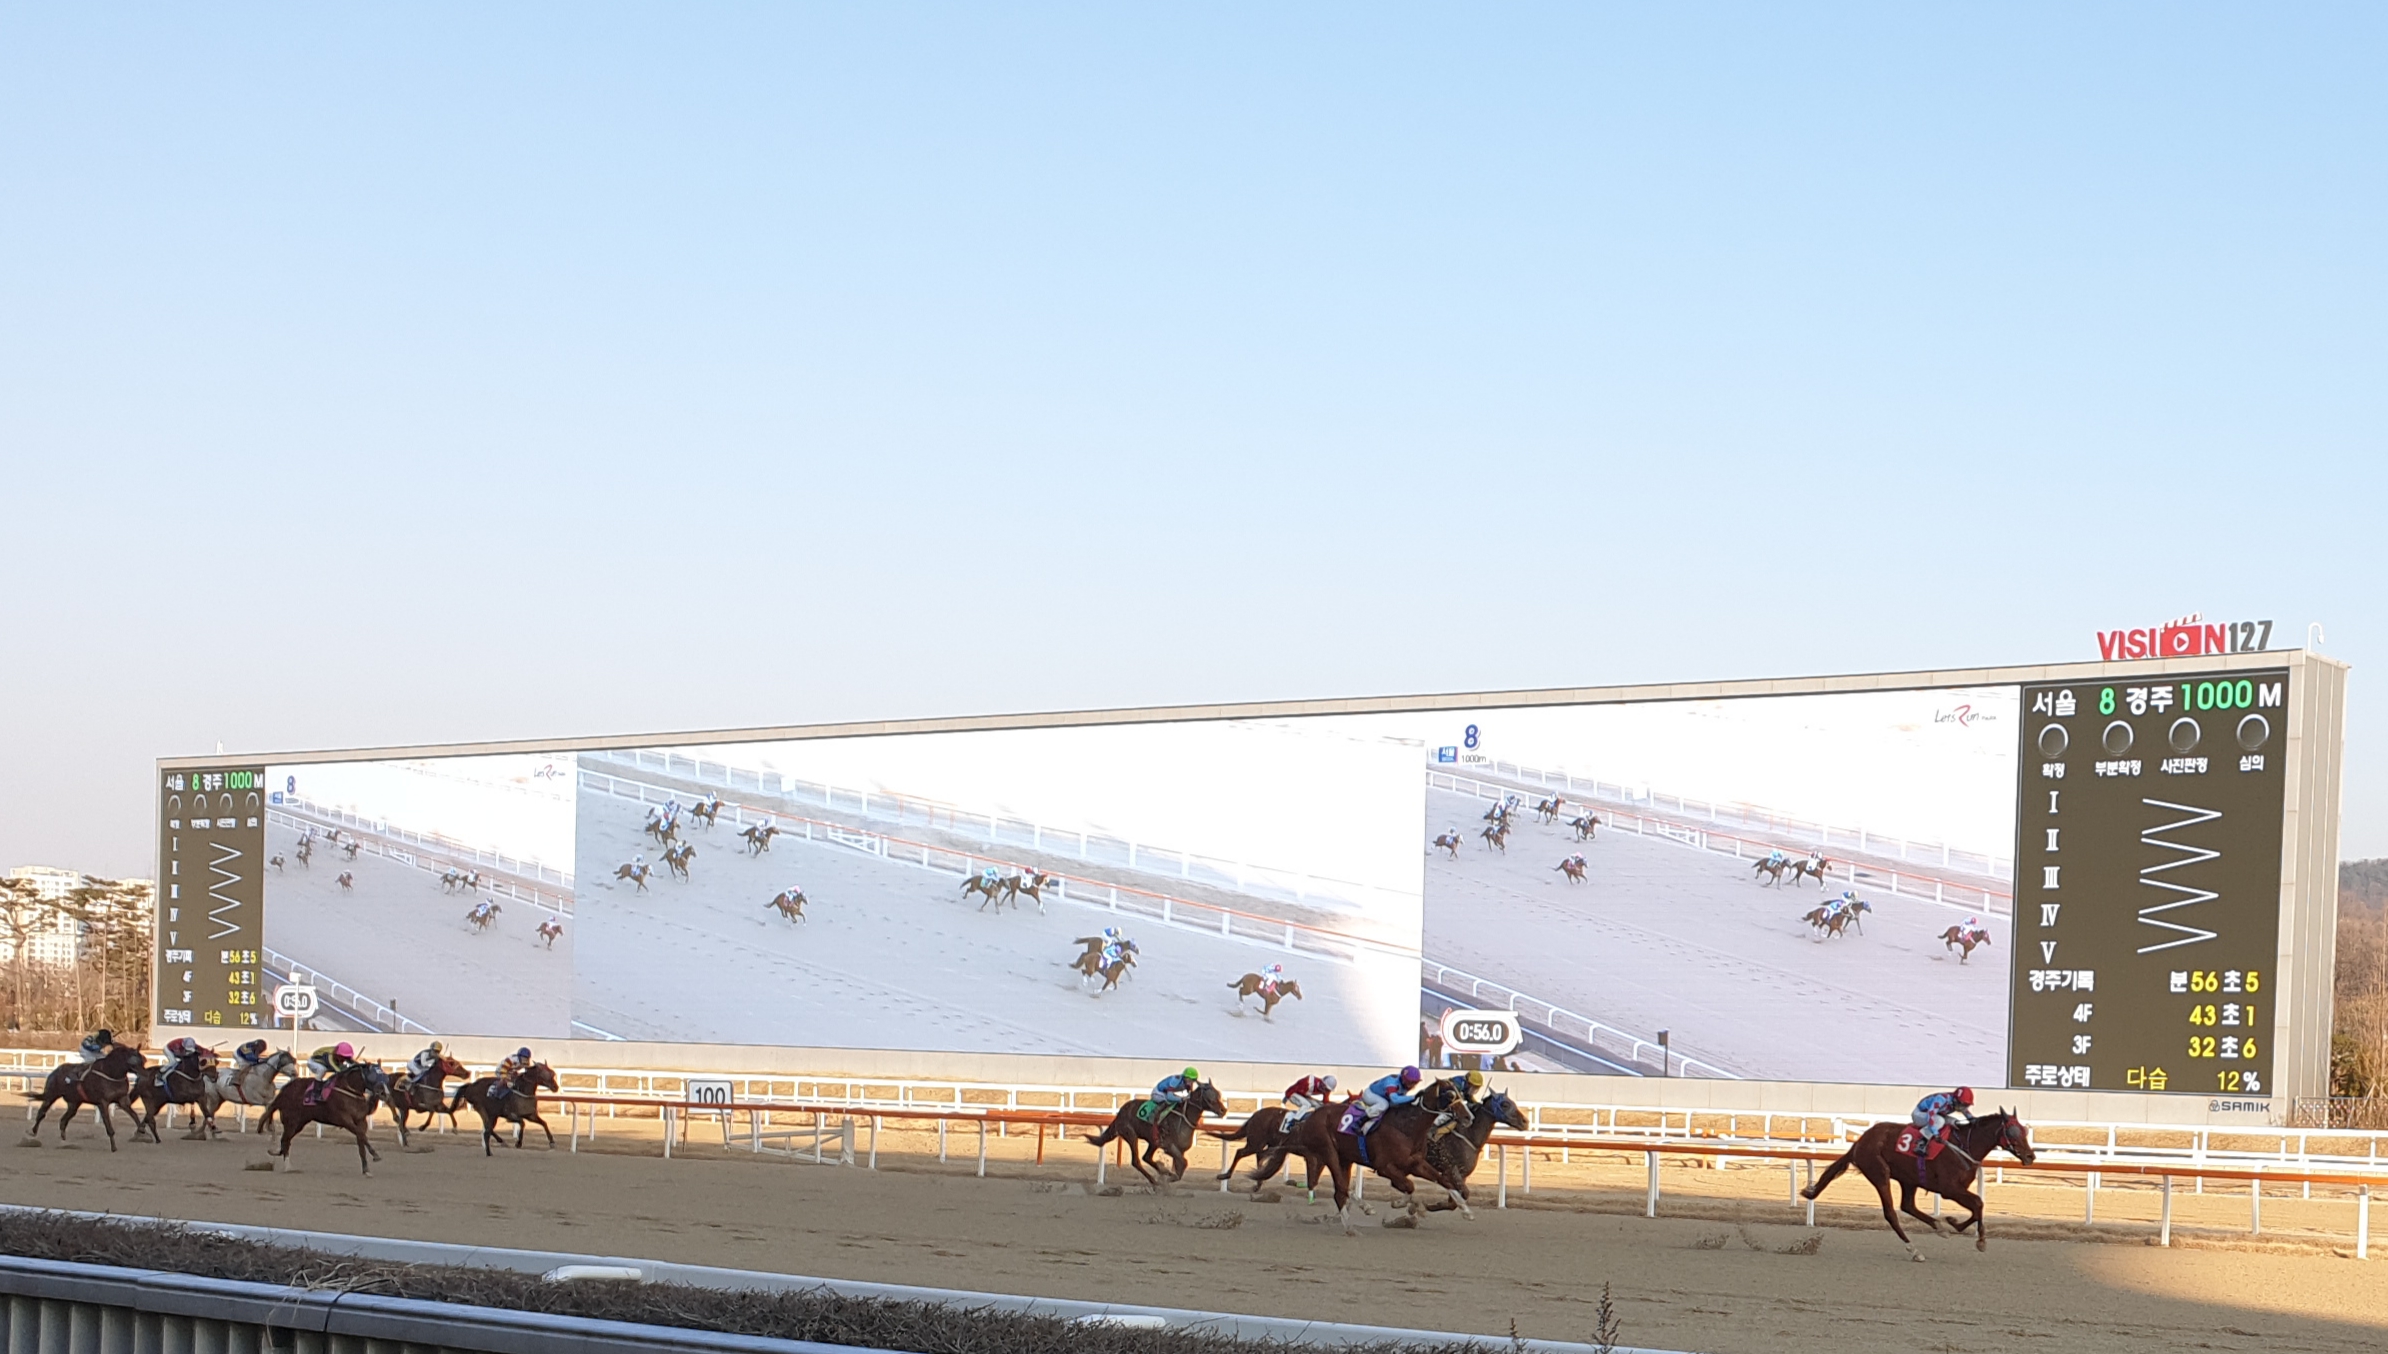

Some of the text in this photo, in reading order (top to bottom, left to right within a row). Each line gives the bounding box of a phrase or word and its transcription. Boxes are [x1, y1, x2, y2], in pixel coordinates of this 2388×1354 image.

[2032, 679, 2282, 716] 서울 8 경주 1000 M
[1463, 723, 1480, 750] 8
[2042, 763, 2065, 778] 확정
[2095, 760, 2142, 776] 부분확정
[2160, 757, 2208, 774] 사진판정
[2239, 755, 2265, 771] 심의
[192, 773, 200, 791] 8
[224, 771, 252, 789] 1000
[2029, 970, 2094, 992] 경주기록
[2073, 1003, 2093, 1022] 4F
[1459, 1023, 1503, 1043] 0:56.0
[2072, 1035, 2092, 1054] 3F
[2024, 1065, 2091, 1088] 주로상태
[2126, 1066, 2168, 1090] 다습
[695, 1086, 726, 1105] 100
[2221, 1101, 2270, 1112] SAMIK
[1340, 1113, 1354, 1131] 9
[1897, 1133, 1913, 1152] 3
